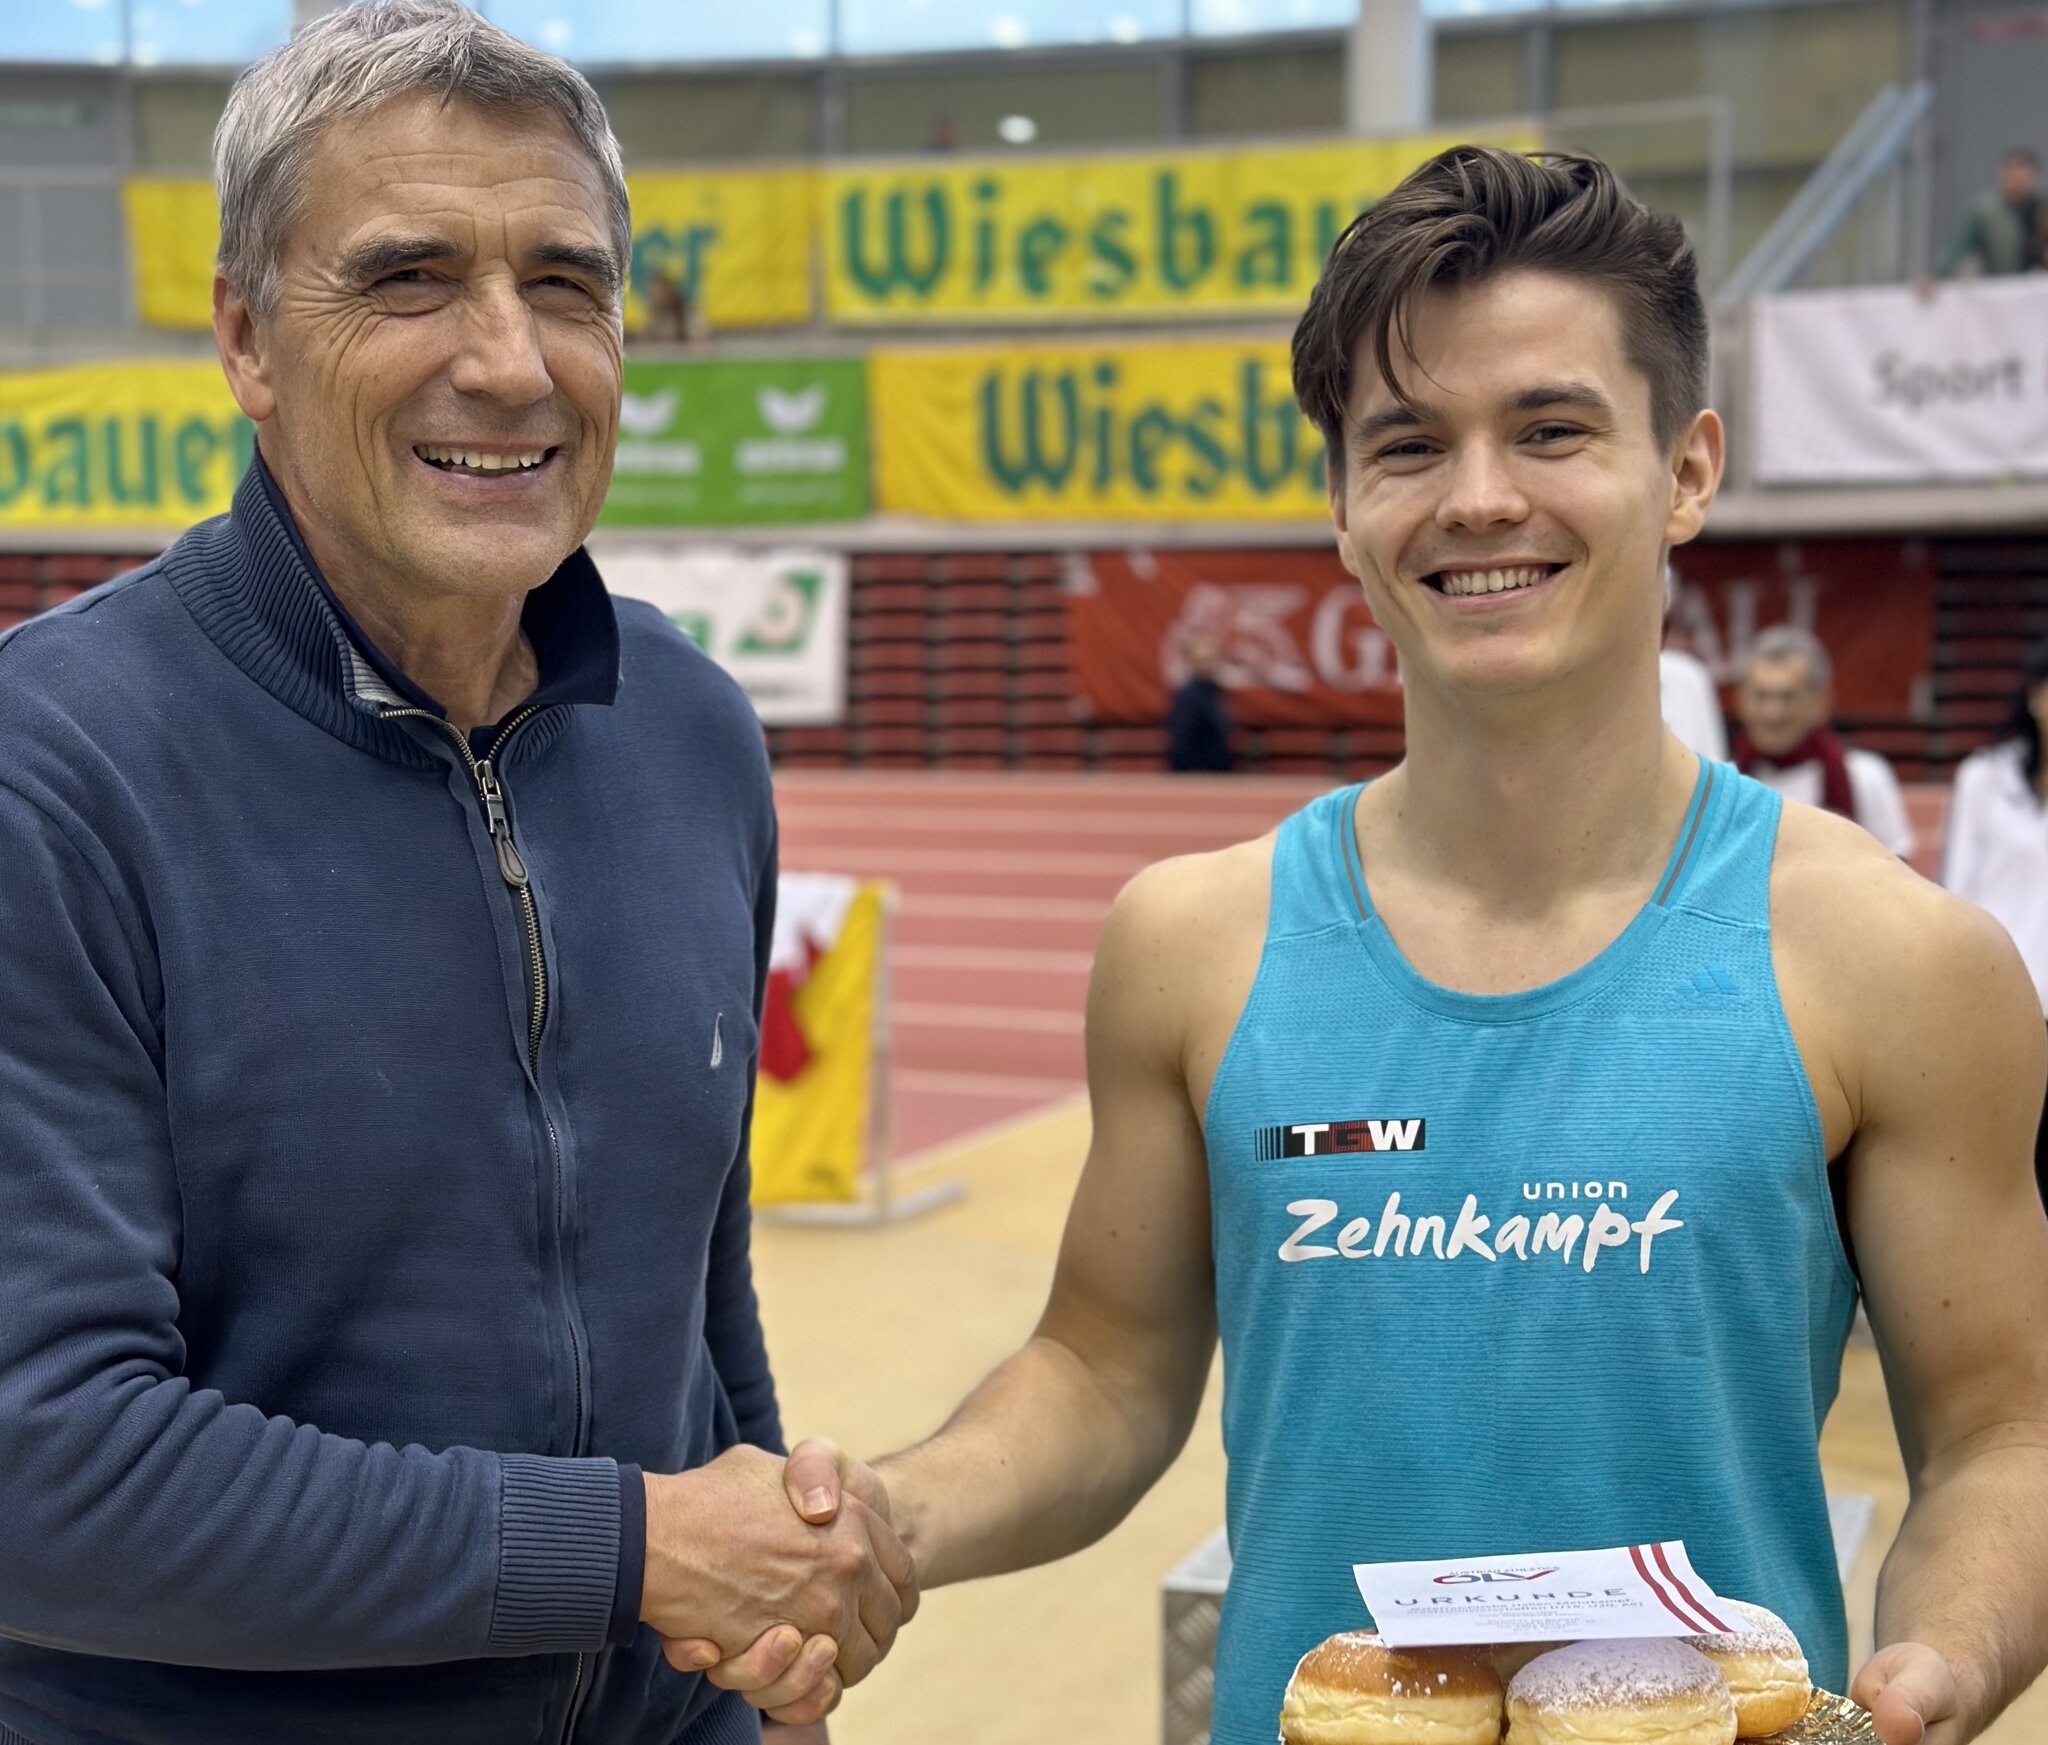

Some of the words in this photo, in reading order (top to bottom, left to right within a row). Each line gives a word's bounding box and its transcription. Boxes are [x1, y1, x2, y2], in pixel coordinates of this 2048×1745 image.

[1871, 349, 2026, 416] Sport
[977, 358, 1329, 500] Wiesb
[1292, 1119, 1421, 1156] TGW
[1278, 1190, 1684, 1274] Zehnkampf
[1395, 1588, 1626, 1606] URKUNDE
